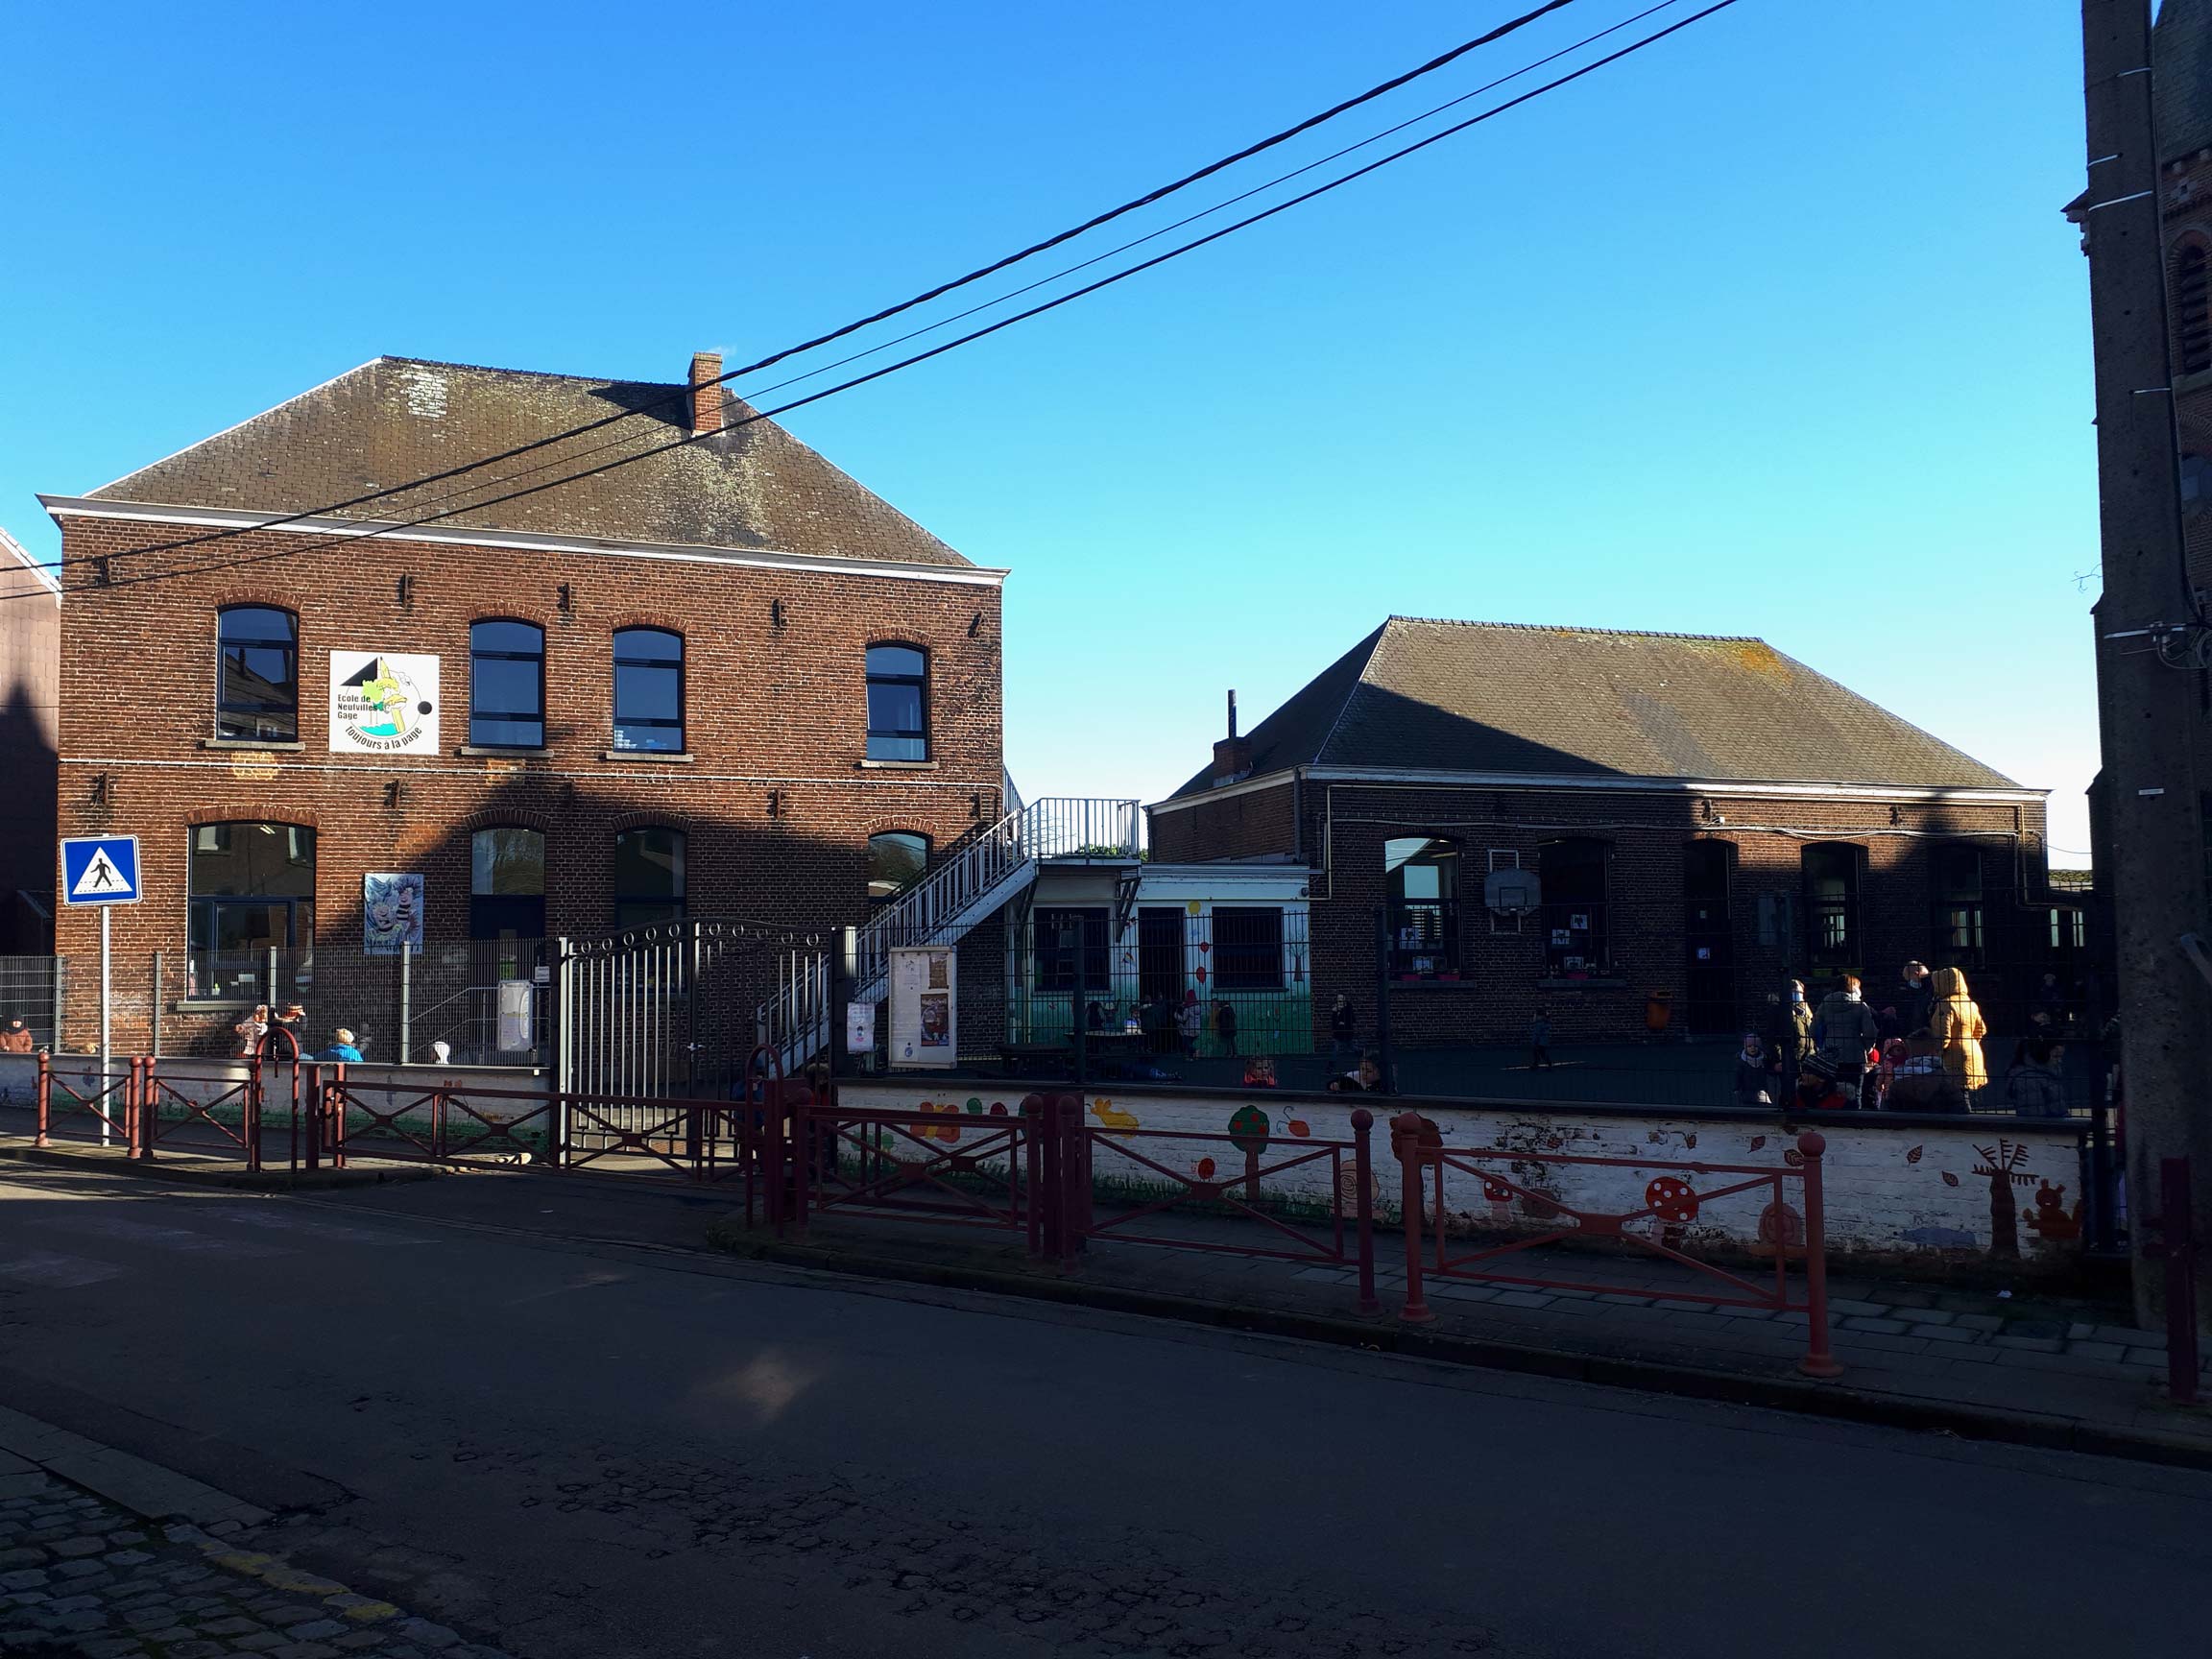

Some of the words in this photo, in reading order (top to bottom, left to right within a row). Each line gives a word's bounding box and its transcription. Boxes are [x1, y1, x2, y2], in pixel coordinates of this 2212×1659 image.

[337, 694, 359, 703] Ecole
[361, 694, 371, 703] de
[337, 703, 377, 711] Neufvilles
[337, 711, 358, 720] Gage
[384, 739, 390, 750] à
[391, 739, 401, 749] la
[401, 727, 422, 747] page
